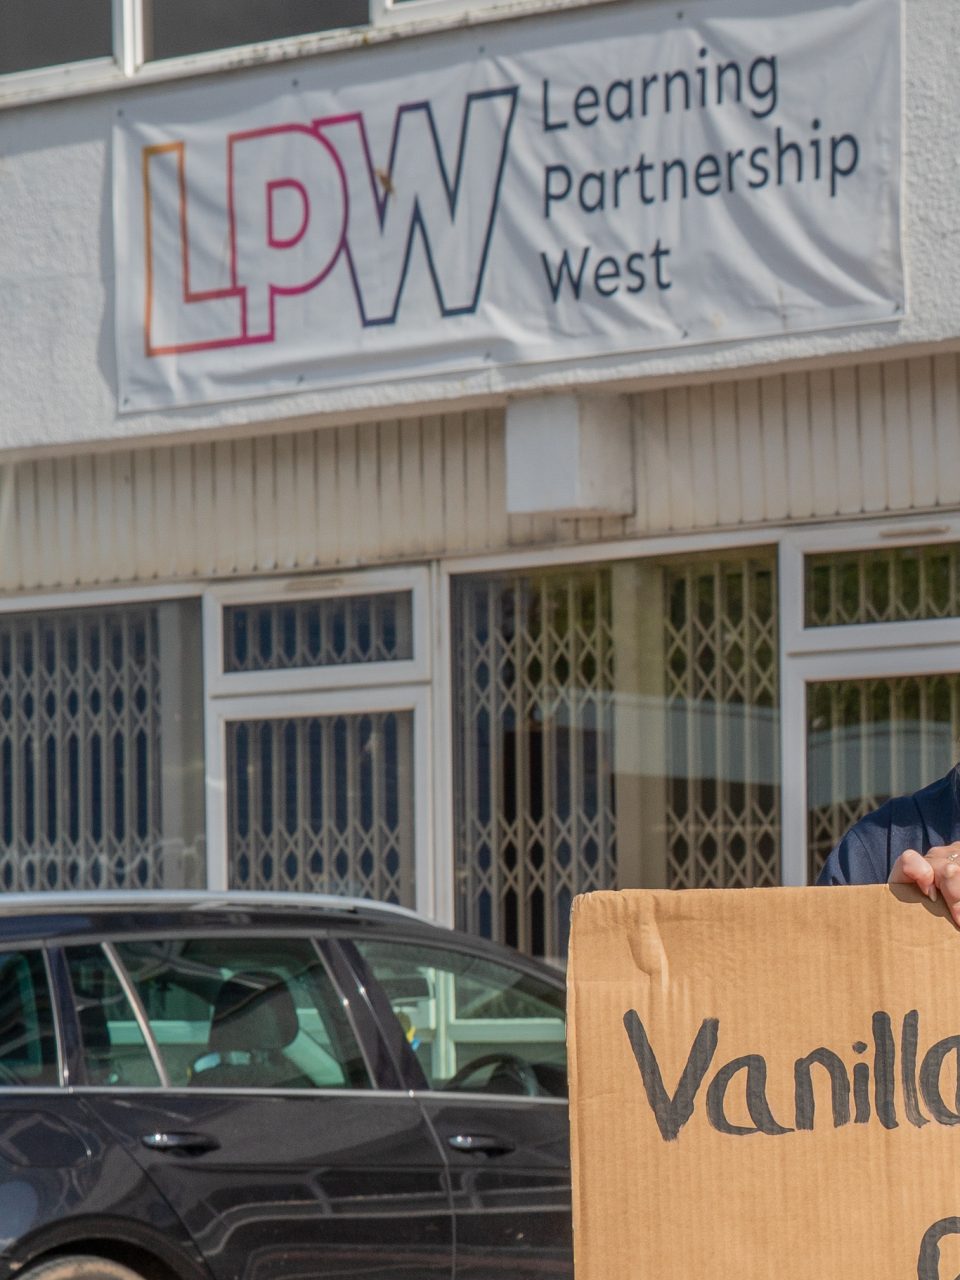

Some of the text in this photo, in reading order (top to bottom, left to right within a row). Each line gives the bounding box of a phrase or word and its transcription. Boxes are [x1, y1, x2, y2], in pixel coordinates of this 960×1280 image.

[543, 47, 778, 132] Learning
[544, 118, 860, 219] Partnership
[142, 86, 519, 357] LPW
[541, 238, 672, 304] West
